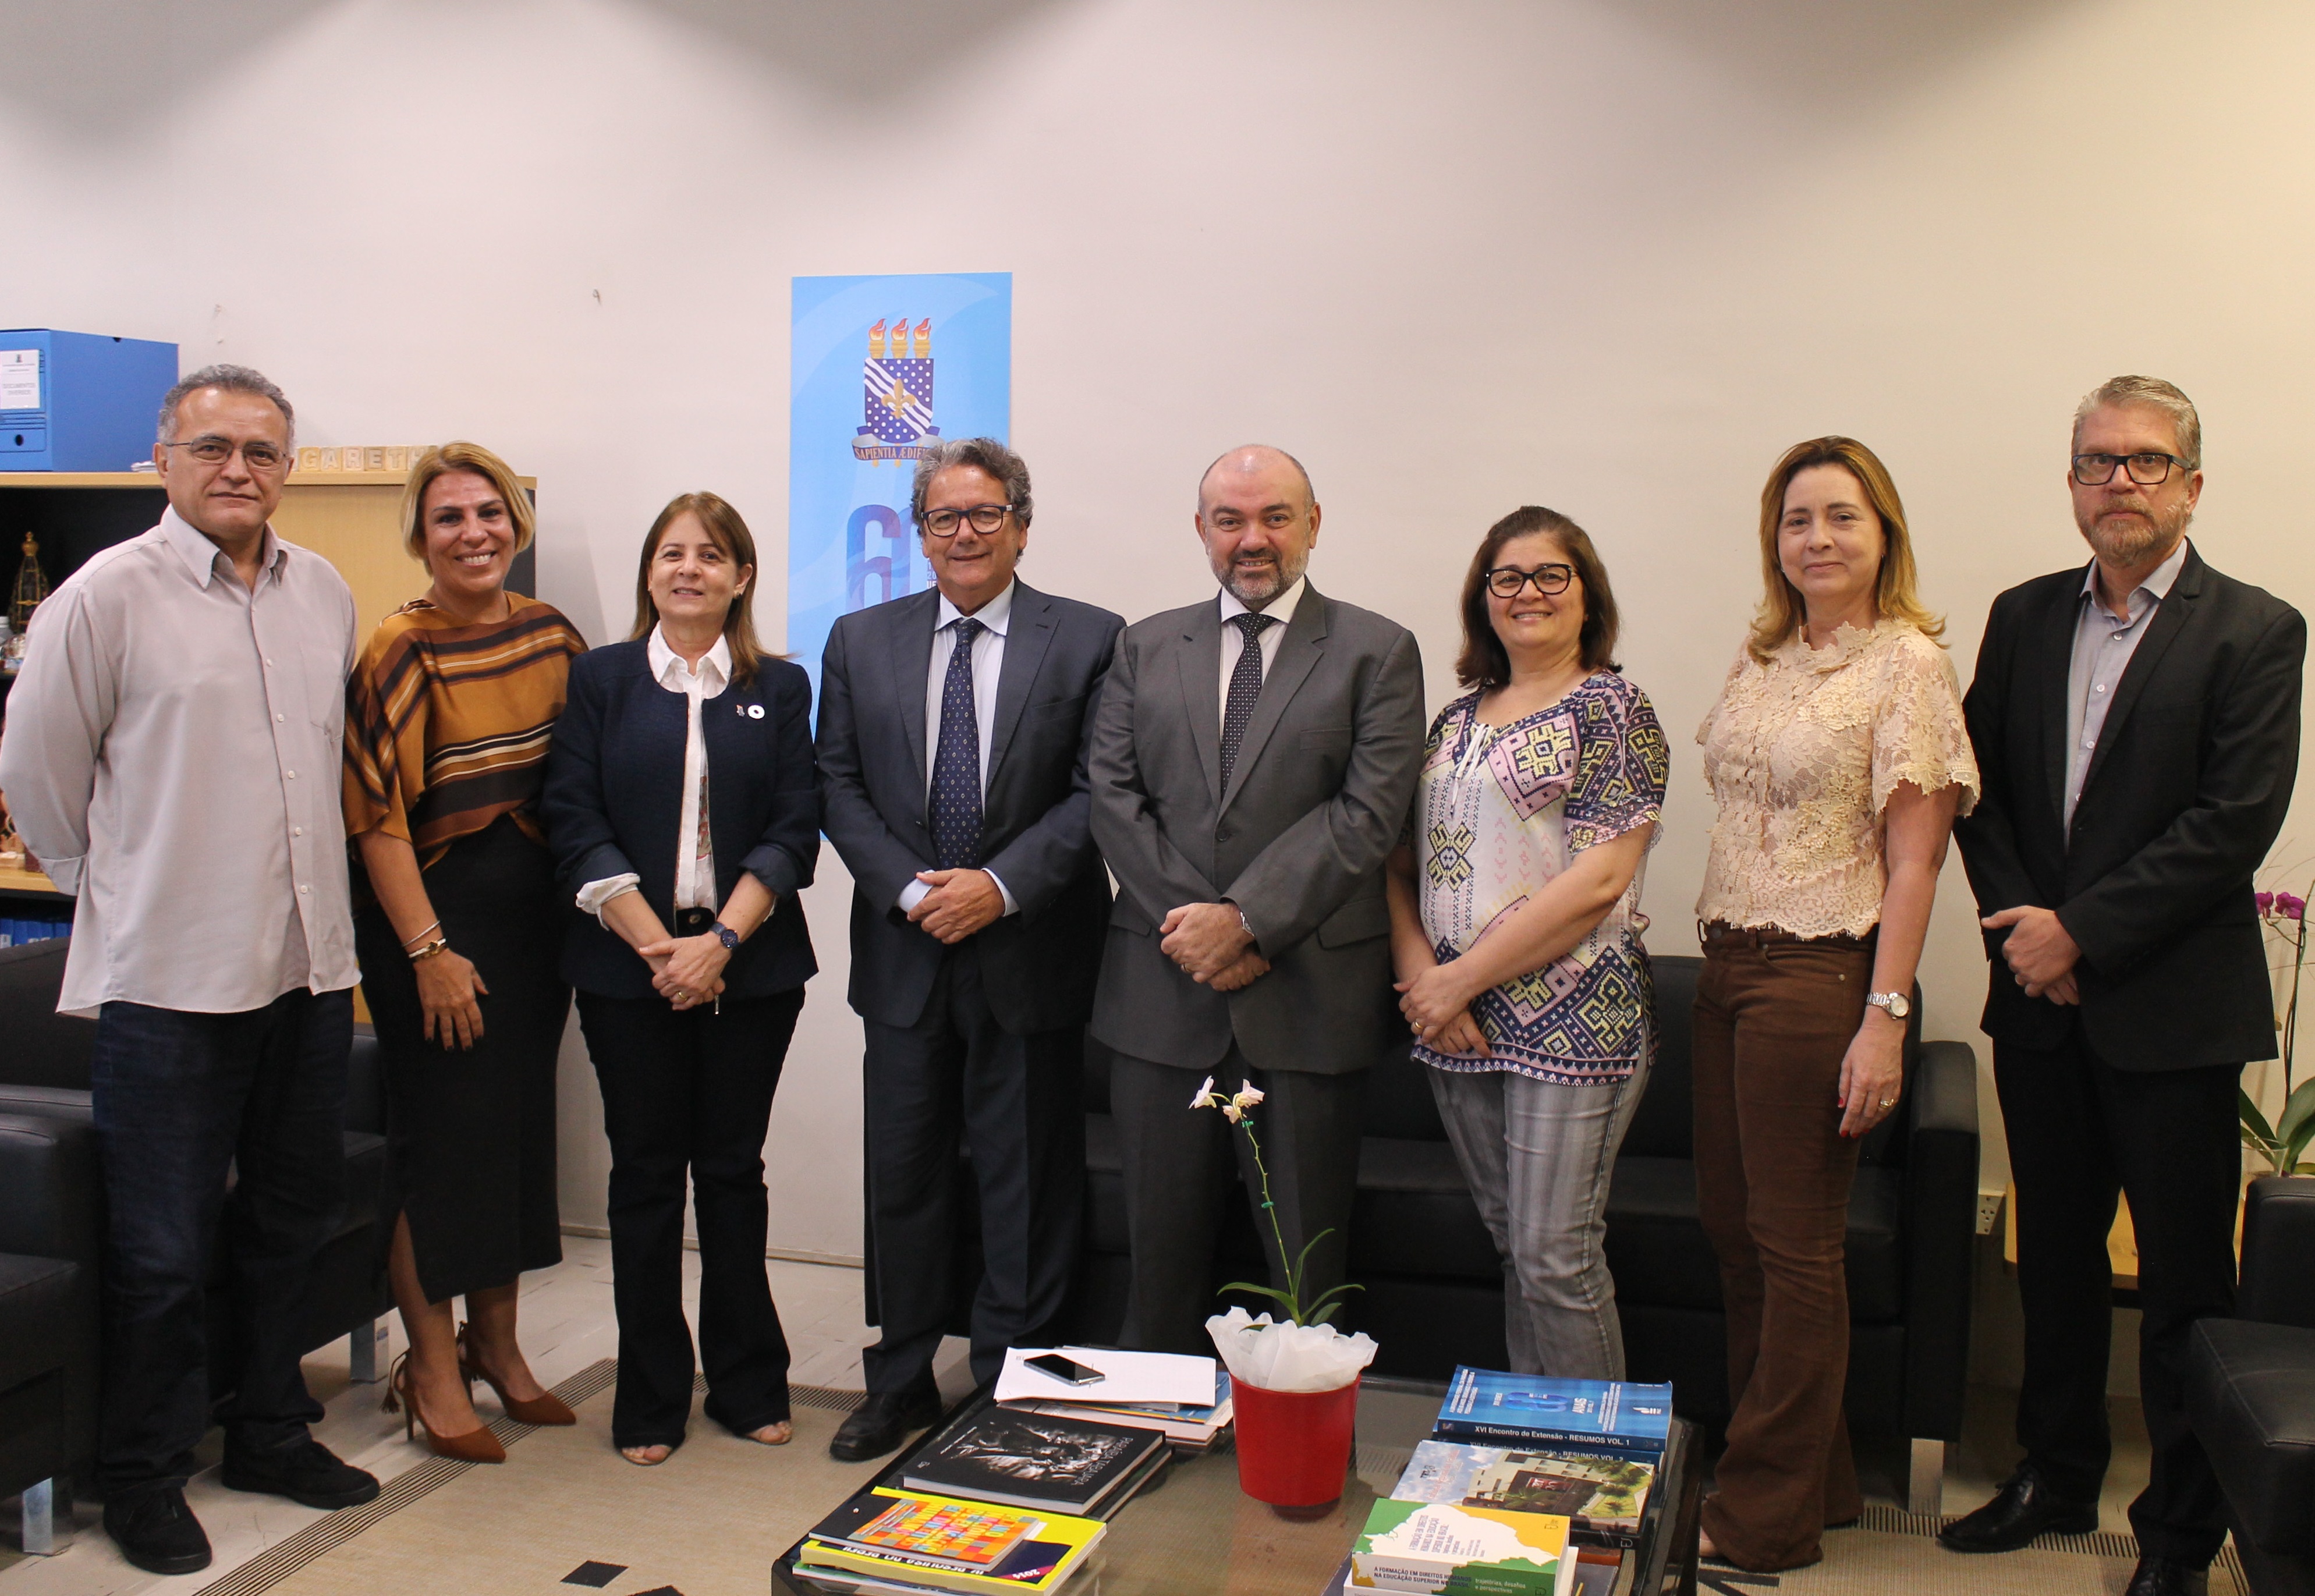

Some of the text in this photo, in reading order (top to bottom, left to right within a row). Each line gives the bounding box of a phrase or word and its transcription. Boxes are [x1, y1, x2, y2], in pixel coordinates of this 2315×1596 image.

[855, 447, 926, 459] SAPIENTIA ÆDIF
[295, 449, 423, 470] GARETH
[1488, 1427, 1519, 1436] Encontro
[1531, 1431, 1563, 1440] Extensão
[1569, 1434, 1605, 1444] RESUMOS
[1607, 1437, 1623, 1445] VOL.
[1012, 1569, 1040, 1580] 2014
[1380, 1567, 1409, 1575] FORMAÇÃO
[1444, 1574, 1472, 1582] HUMANOS
[1383, 1573, 1412, 1581] EDUCAÇÃO
[1480, 1585, 1512, 1594] perspectivas
